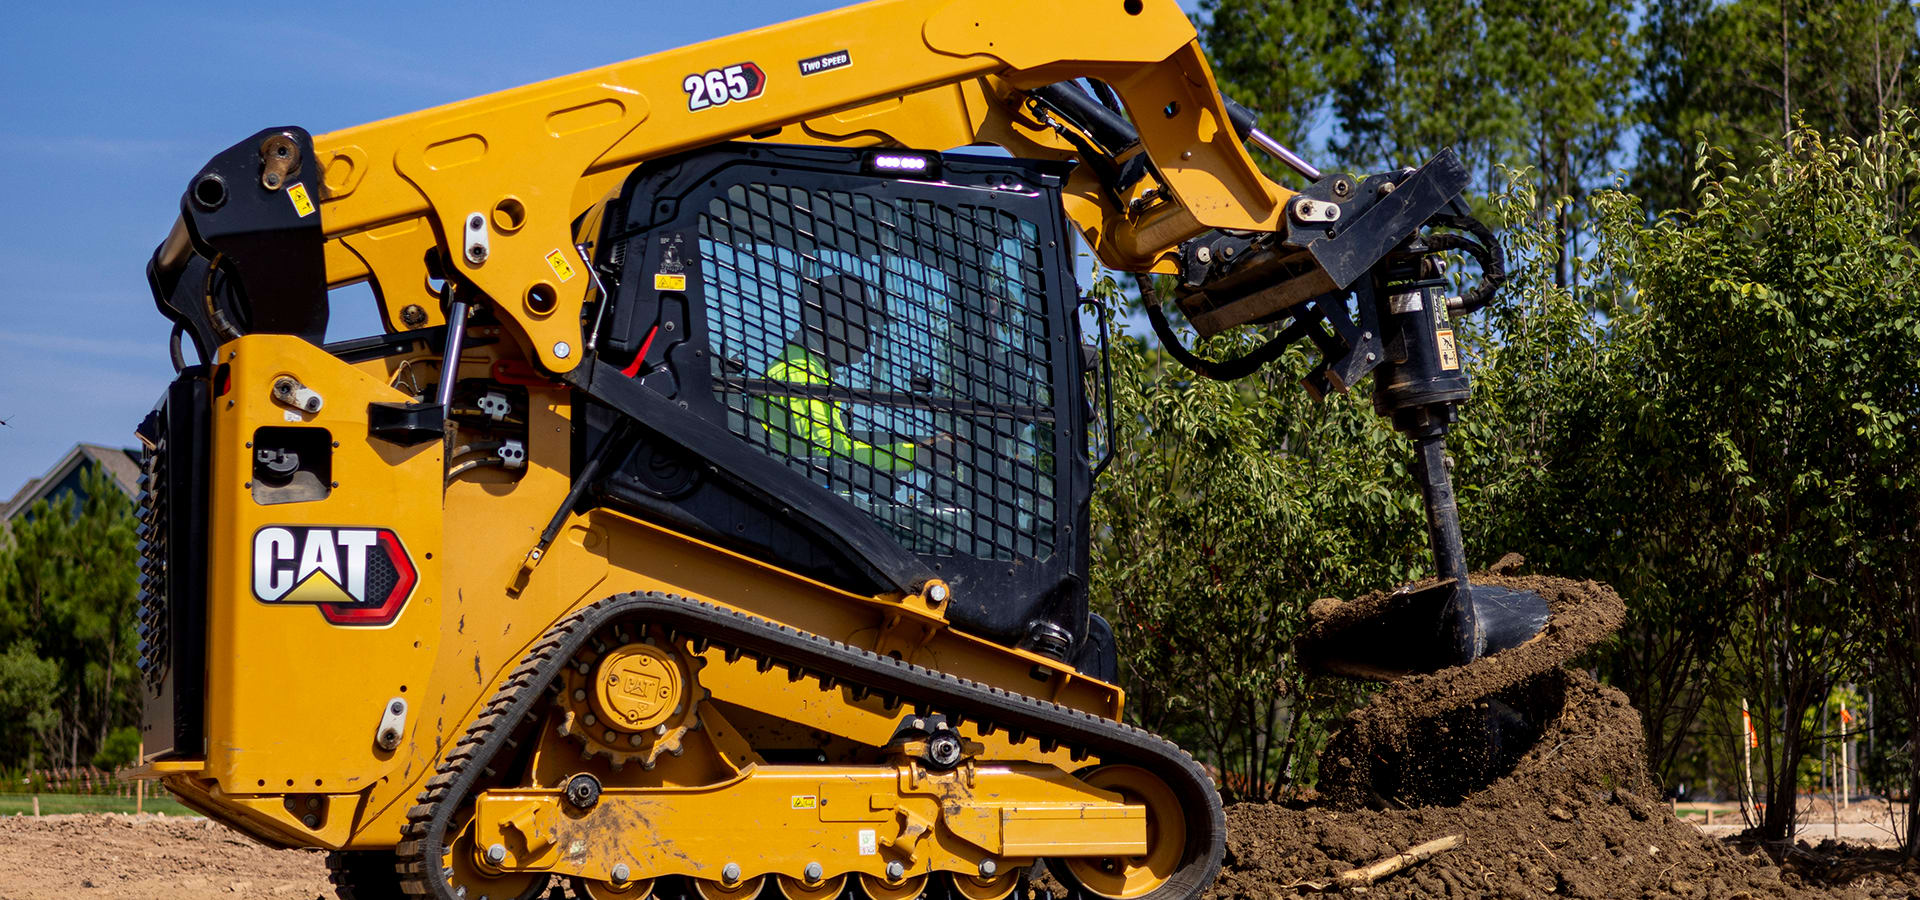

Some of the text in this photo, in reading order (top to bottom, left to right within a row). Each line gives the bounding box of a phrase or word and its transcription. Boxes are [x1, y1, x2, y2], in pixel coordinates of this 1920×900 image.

[802, 54, 847, 73] TWO SPEED
[684, 65, 749, 110] 265
[255, 527, 377, 602] CAT
[624, 676, 655, 698] CAT
